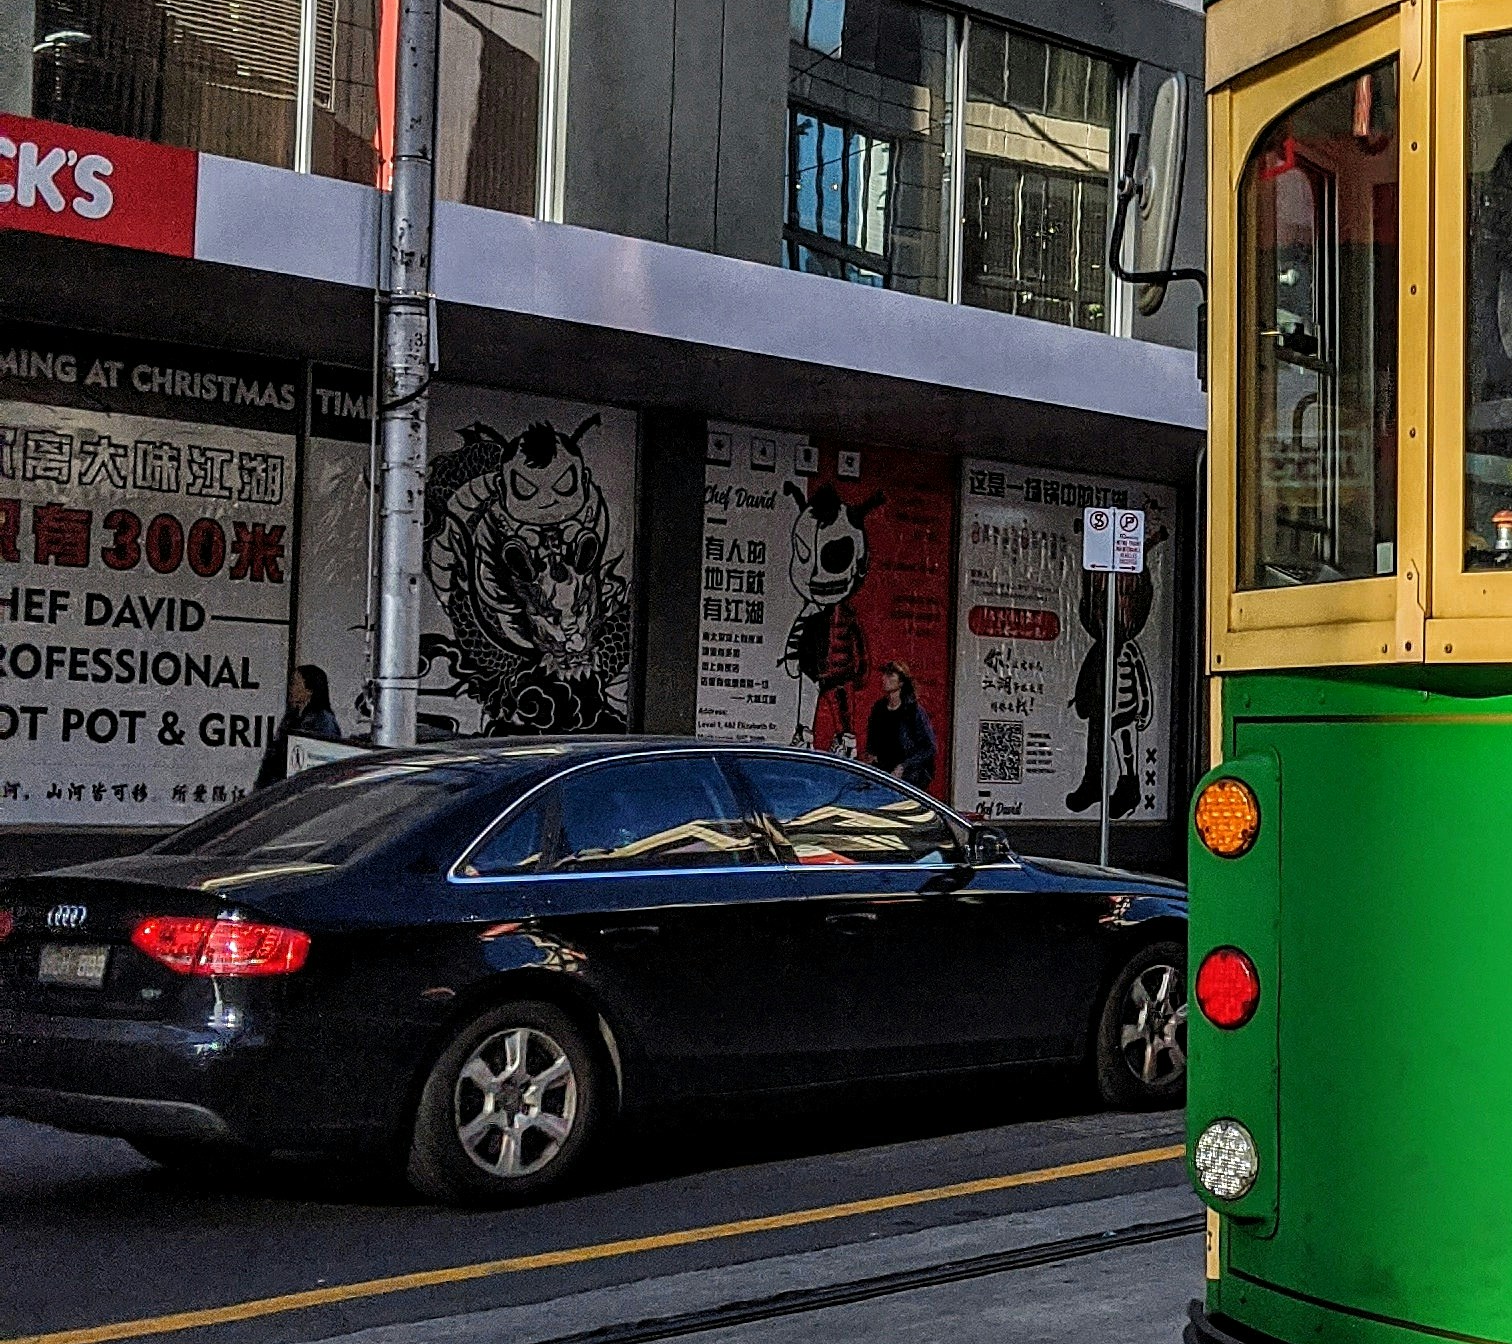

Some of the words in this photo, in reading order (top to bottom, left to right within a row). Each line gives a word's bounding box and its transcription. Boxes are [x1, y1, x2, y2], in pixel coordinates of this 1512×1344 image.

[84, 359, 124, 387] AT
[131, 364, 296, 411] CHRISTMAS
[703, 483, 733, 511] Chef
[735, 487, 778, 510] David
[705, 536, 766, 565] 有人的
[84, 592, 206, 632] DAVID
[703, 597, 764, 625] 有江湖
[0, 643, 260, 690] OFESSIONAL
[61, 707, 147, 744] POT
[157, 710, 186, 746] &
